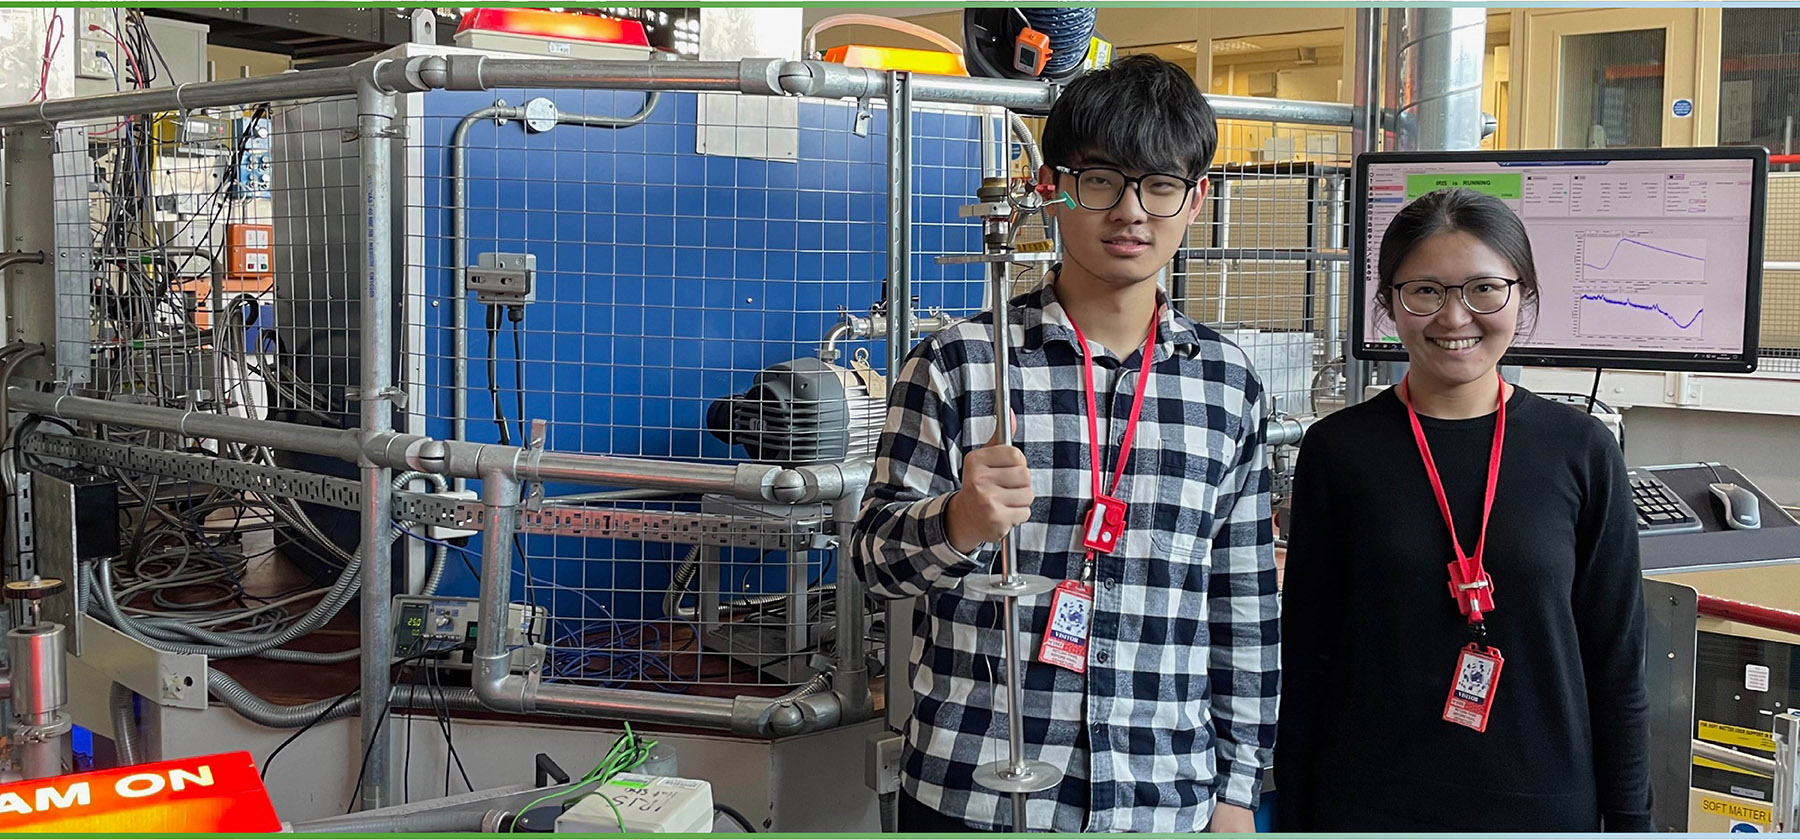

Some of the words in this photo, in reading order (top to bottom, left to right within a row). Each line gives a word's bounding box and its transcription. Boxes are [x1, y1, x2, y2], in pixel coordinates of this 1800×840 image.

[1055, 631, 1079, 643] VISITOR
[0, 782, 90, 814] AM
[114, 765, 214, 798] ON
[1702, 799, 1727, 813] SOFT
[1729, 805, 1766, 821] MATTER
